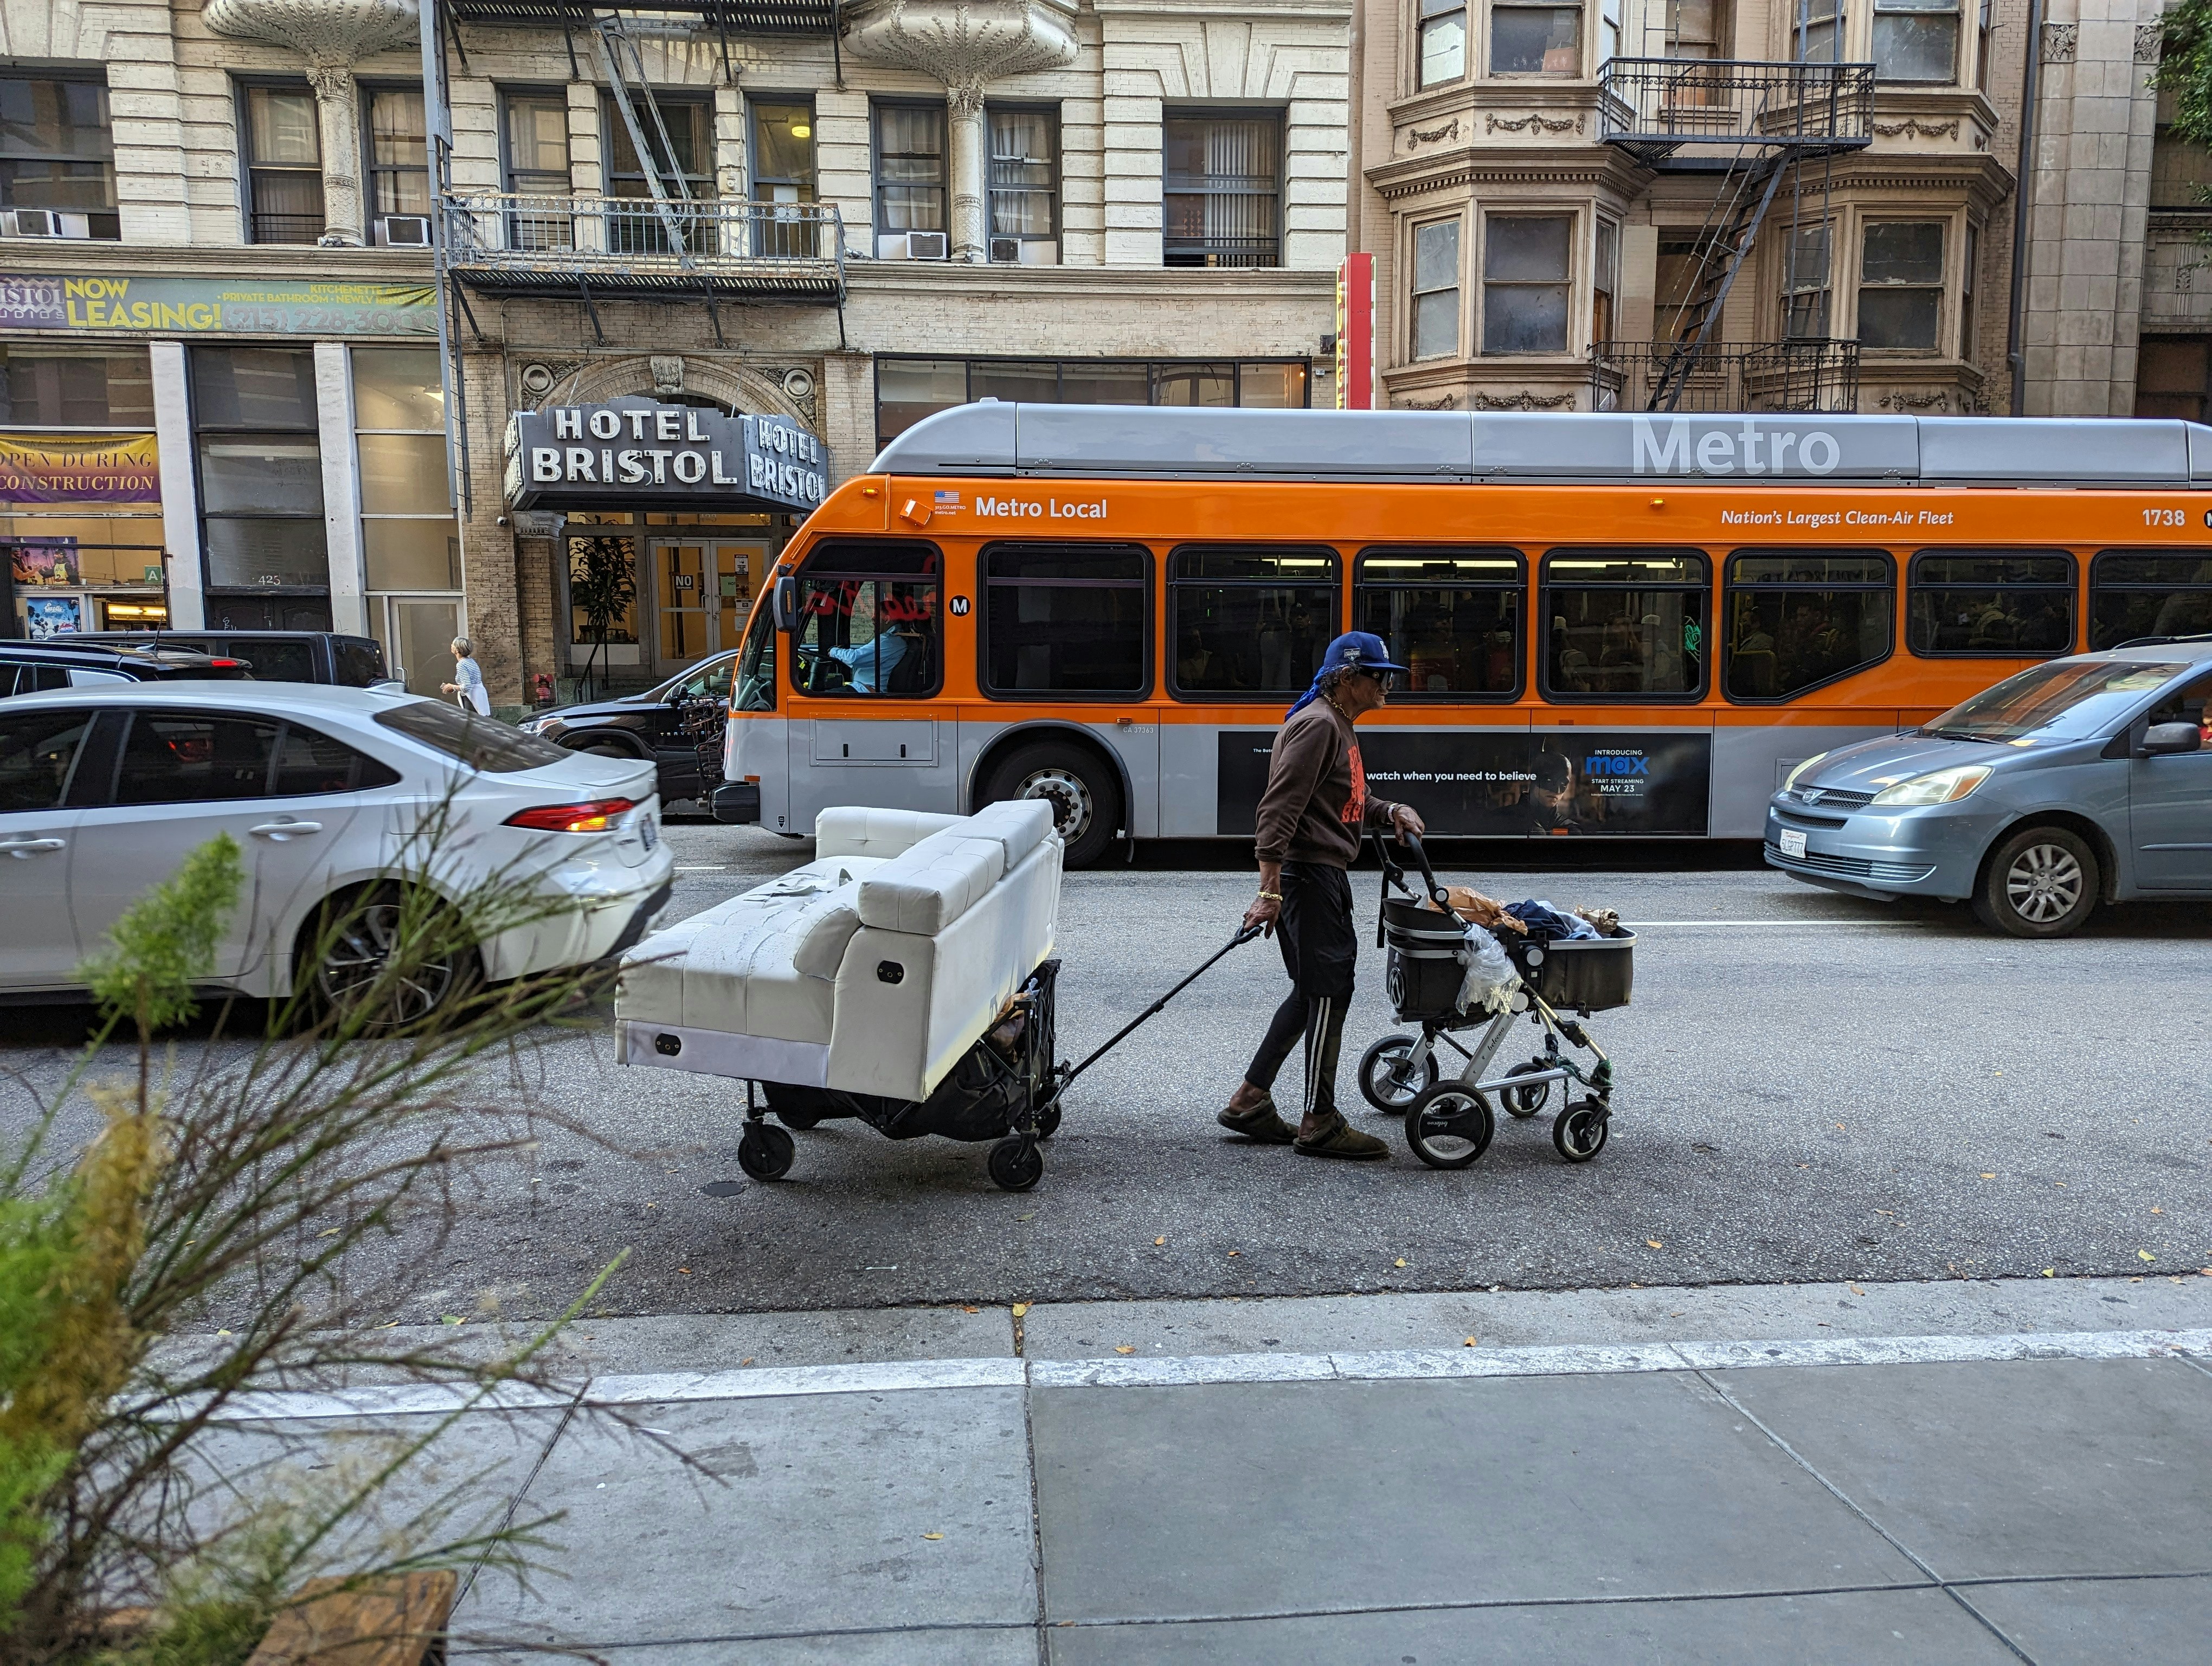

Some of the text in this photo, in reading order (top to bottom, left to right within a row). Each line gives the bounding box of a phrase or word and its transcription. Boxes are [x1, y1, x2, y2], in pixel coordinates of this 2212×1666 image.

[65, 278, 130, 299] NOW
[310, 285, 383, 294] KITCHENETTE
[223, 292, 265, 302] PRIVATE
[267, 293, 329, 303] BATHROOM
[336, 296, 374, 304] NEWLY
[66, 300, 222, 330] LEASING!
[223, 305, 288, 330] (213)
[555, 409, 710, 441] HOTEL
[757, 418, 821, 465] HOTEL
[1632, 417, 1840, 475] Metro
[62, 452, 151, 467] DURING
[532, 447, 738, 484] BRISTOL
[0, 475, 154, 490] CONSTRUCTION
[976, 497, 1107, 518] Metro Local
[1787, 511, 1841, 528] Largest
[1846, 511, 1913, 524] Clean-Air
[1918, 511, 1953, 524] Fleet
[2143, 509, 2185, 526] 1738
[148, 571, 158, 581] A
[258, 575, 280, 585] 425
[676, 575, 692, 586] NO
[1585, 756, 1650, 774] max
[1366, 771, 1537, 783] watch when you need to believe
[1487, 1027, 1504, 1051] belecoo
